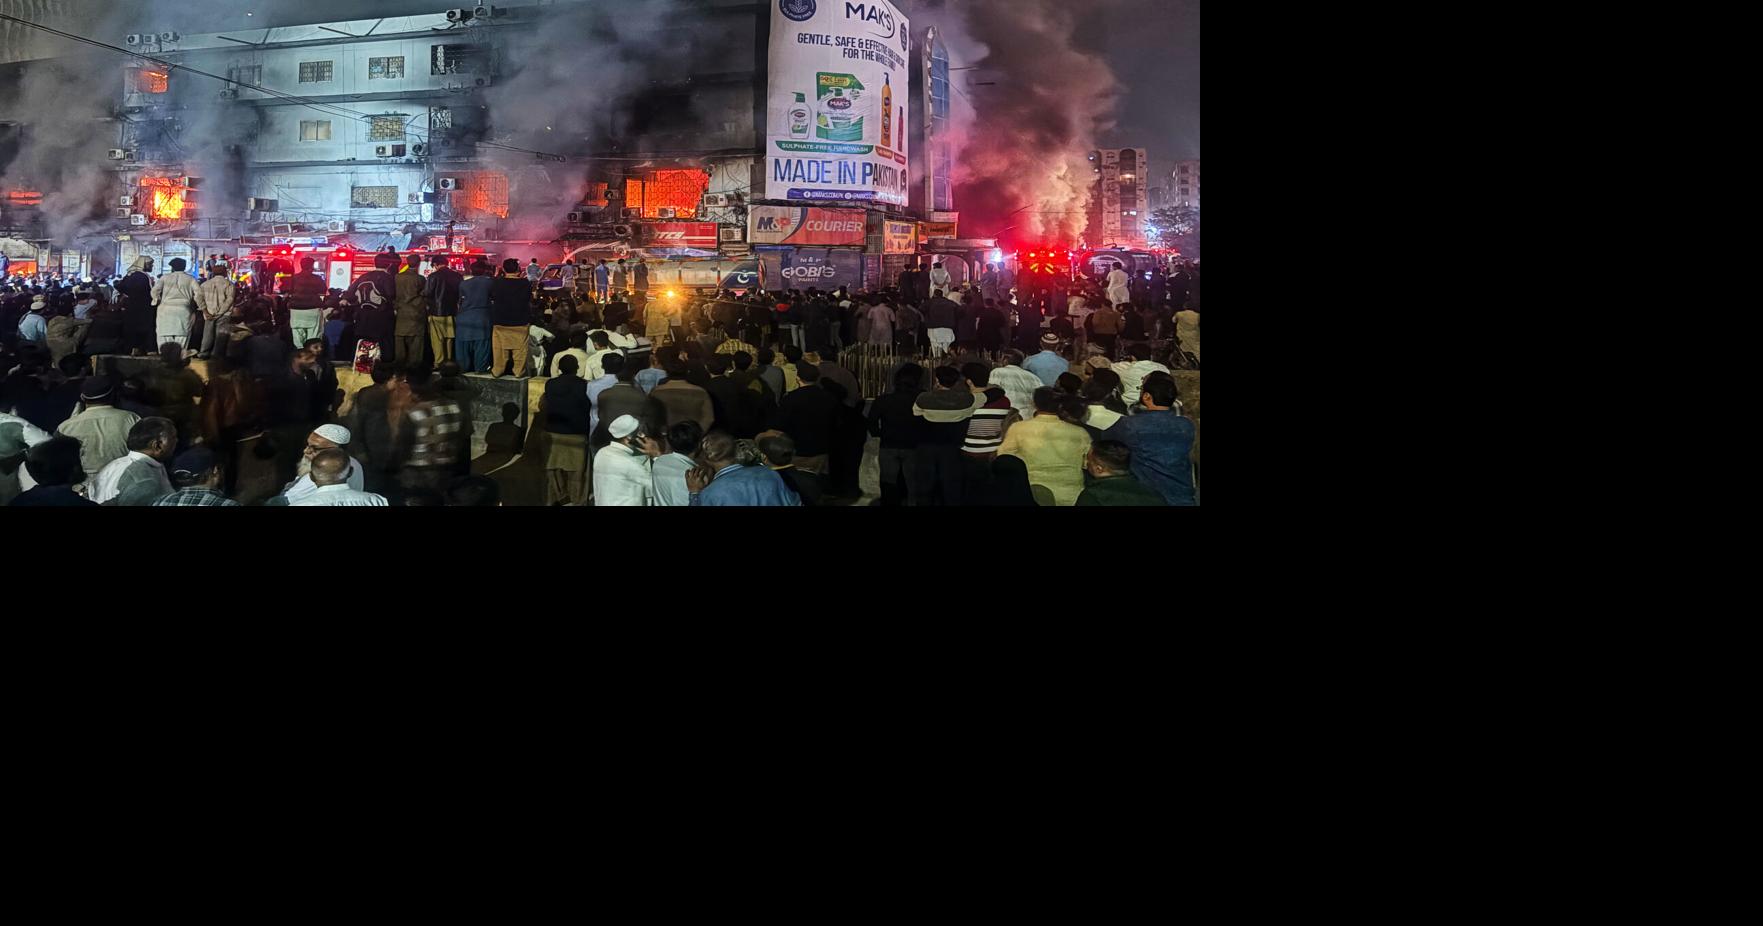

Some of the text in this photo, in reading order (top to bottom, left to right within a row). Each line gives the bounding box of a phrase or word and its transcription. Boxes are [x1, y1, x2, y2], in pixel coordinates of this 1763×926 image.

[845, 1, 892, 31] MAK'S
[797, 32, 833, 47] GENTLE,
[835, 35, 856, 48] SAFE
[858, 38, 864, 49] &
[843, 48, 859, 60] FOR
[860, 49, 875, 61] THE
[774, 158, 898, 188] MADE IN PAKISTAN
[757, 216, 864, 233] M&P COURIER
